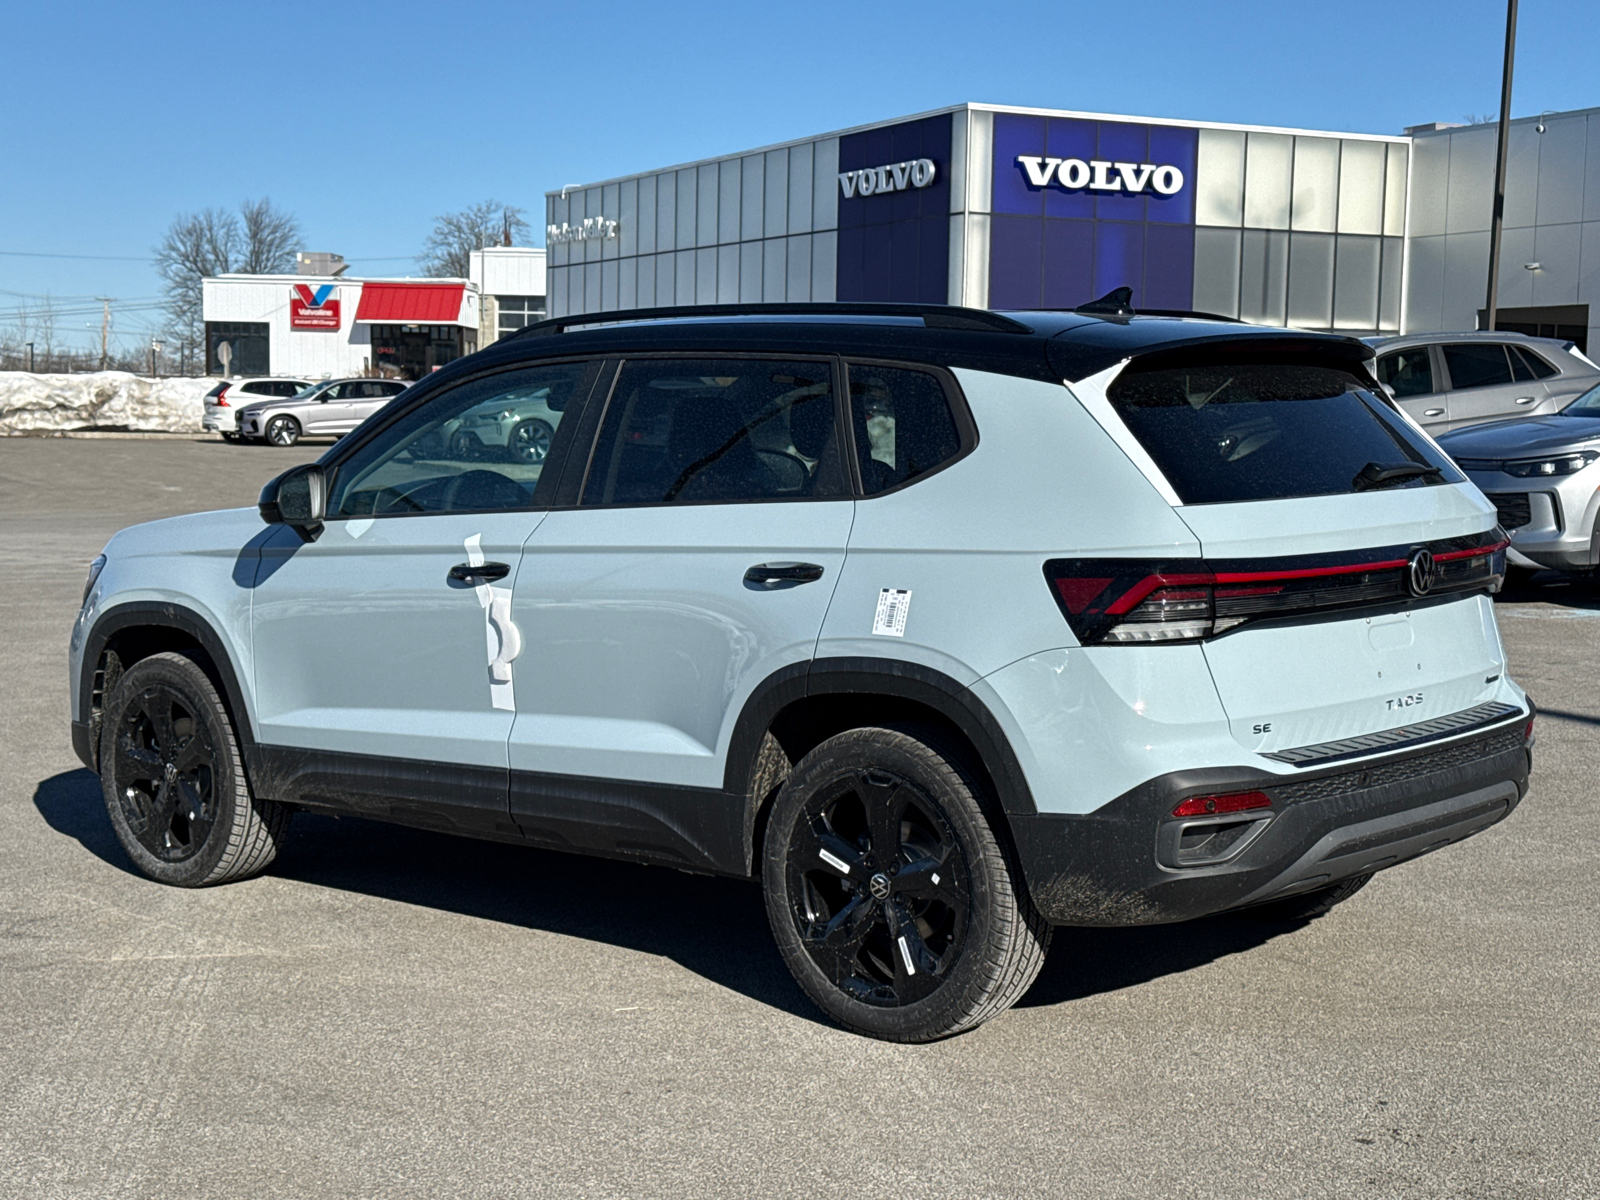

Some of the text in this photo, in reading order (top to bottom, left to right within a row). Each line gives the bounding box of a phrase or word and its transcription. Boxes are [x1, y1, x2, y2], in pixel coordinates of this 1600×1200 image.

[838, 158, 936, 199] VOLVO
[1018, 155, 1184, 195] VOLVO
[1386, 693, 1424, 711] TAOS
[1252, 722, 1272, 735] SE
